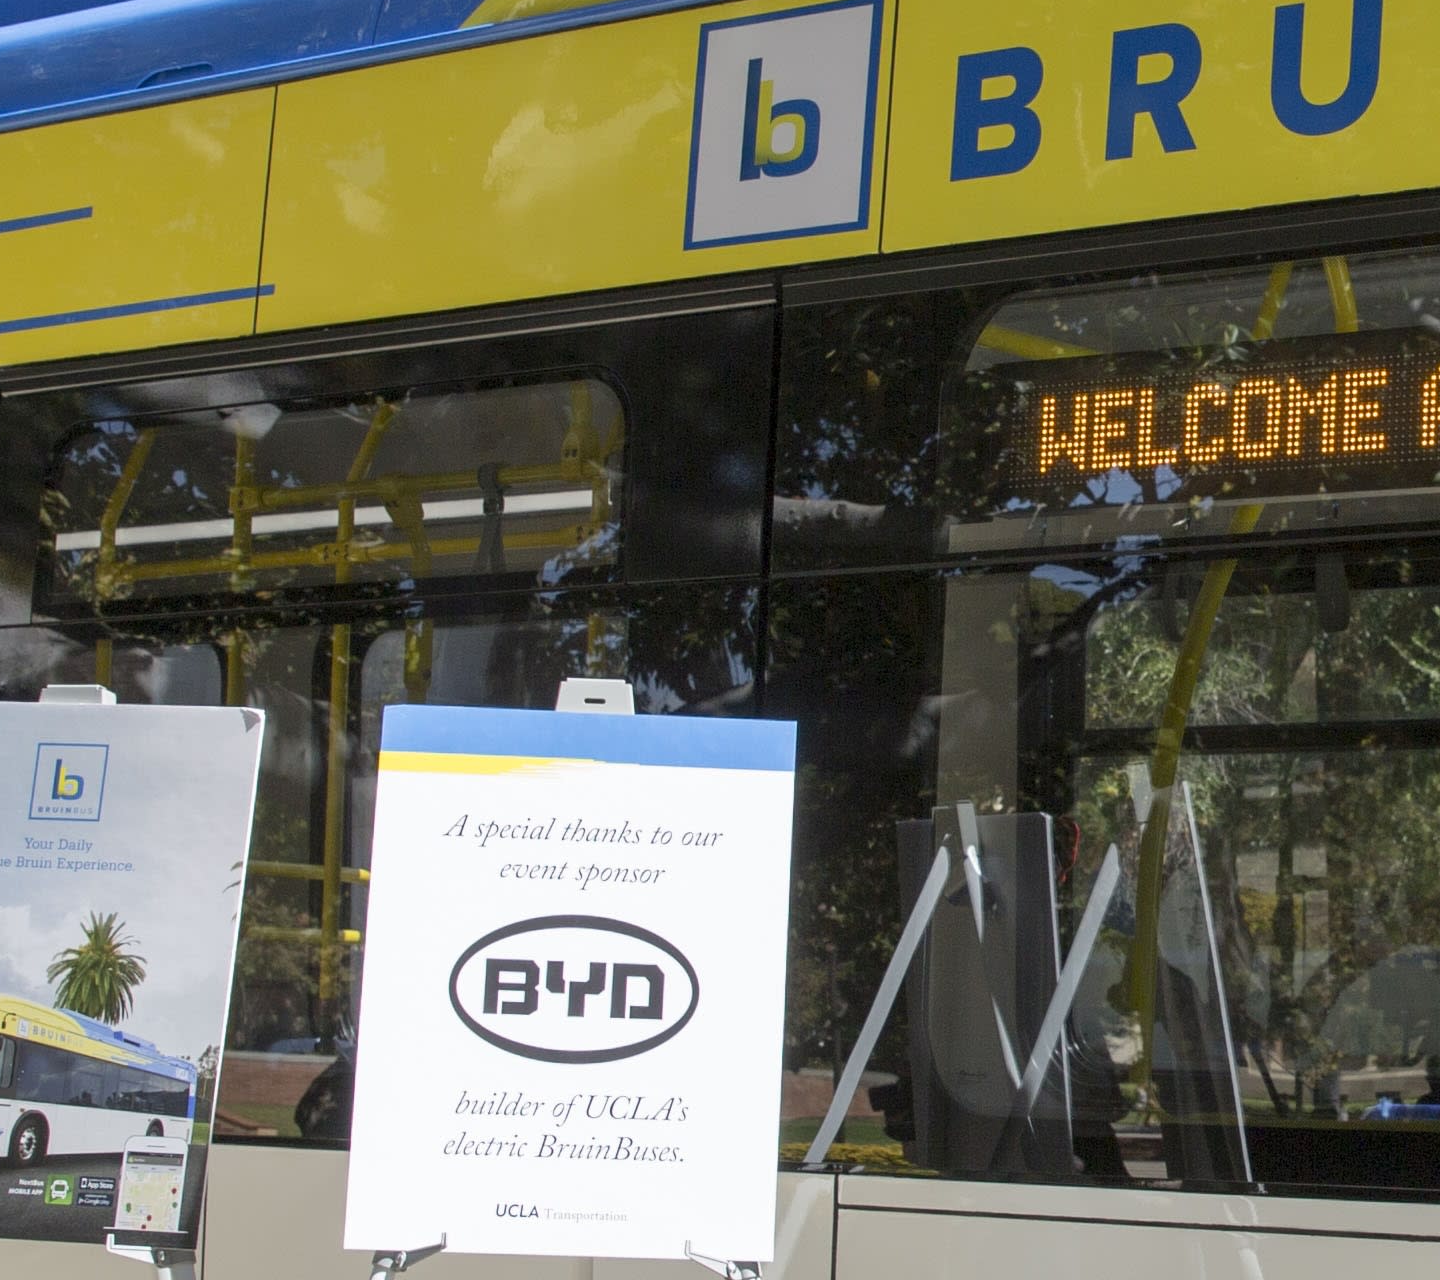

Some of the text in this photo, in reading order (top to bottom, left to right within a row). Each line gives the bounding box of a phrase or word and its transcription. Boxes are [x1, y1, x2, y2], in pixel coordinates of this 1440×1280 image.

[1039, 367, 1389, 475] WELCOME
[37, 806, 94, 815] BRUINBUS
[25, 837, 93, 853] Your Daily
[443, 814, 724, 848] A special thanks to our
[15, 856, 53, 870] Bruin
[56, 857, 136, 872] Experience.
[500, 861, 667, 891] event sponsor
[482, 958, 665, 1021] BYD
[454, 1090, 689, 1128] builder of UCLA's
[443, 1131, 685, 1163] electric BruinBuses.
[495, 1203, 629, 1223] UCLA Transportation
